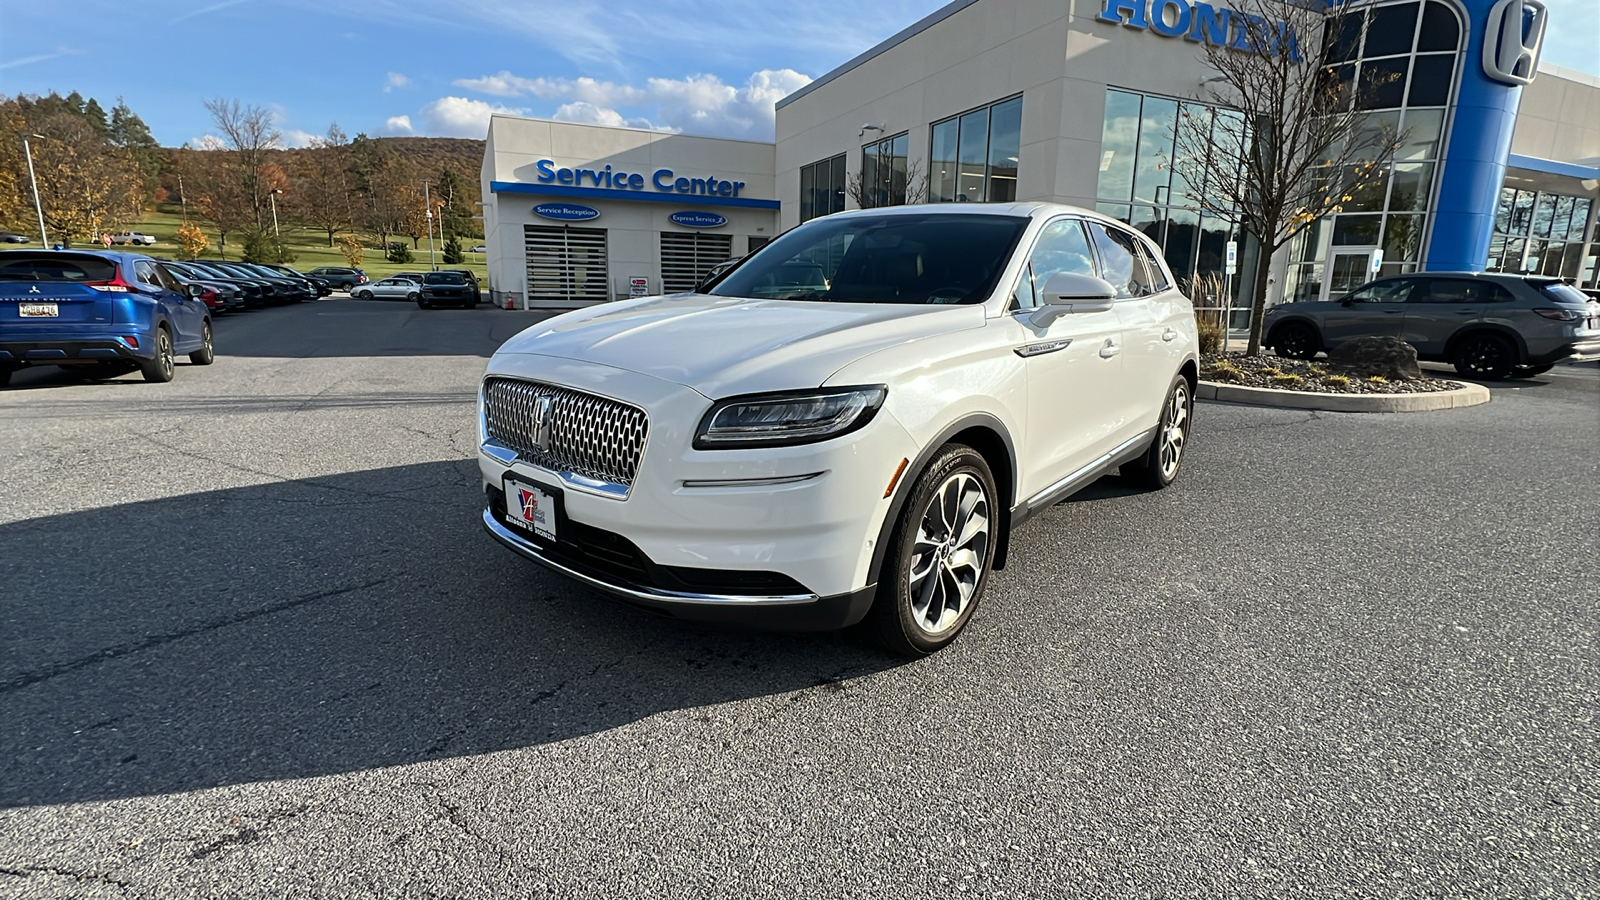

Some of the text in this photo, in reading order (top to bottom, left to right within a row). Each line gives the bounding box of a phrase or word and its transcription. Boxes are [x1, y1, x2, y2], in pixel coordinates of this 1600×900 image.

[1097, 0, 1303, 63] HONDA
[536, 159, 745, 197] Service Center
[537, 206, 596, 216] Service Reception
[672, 214, 716, 223] Express Service
